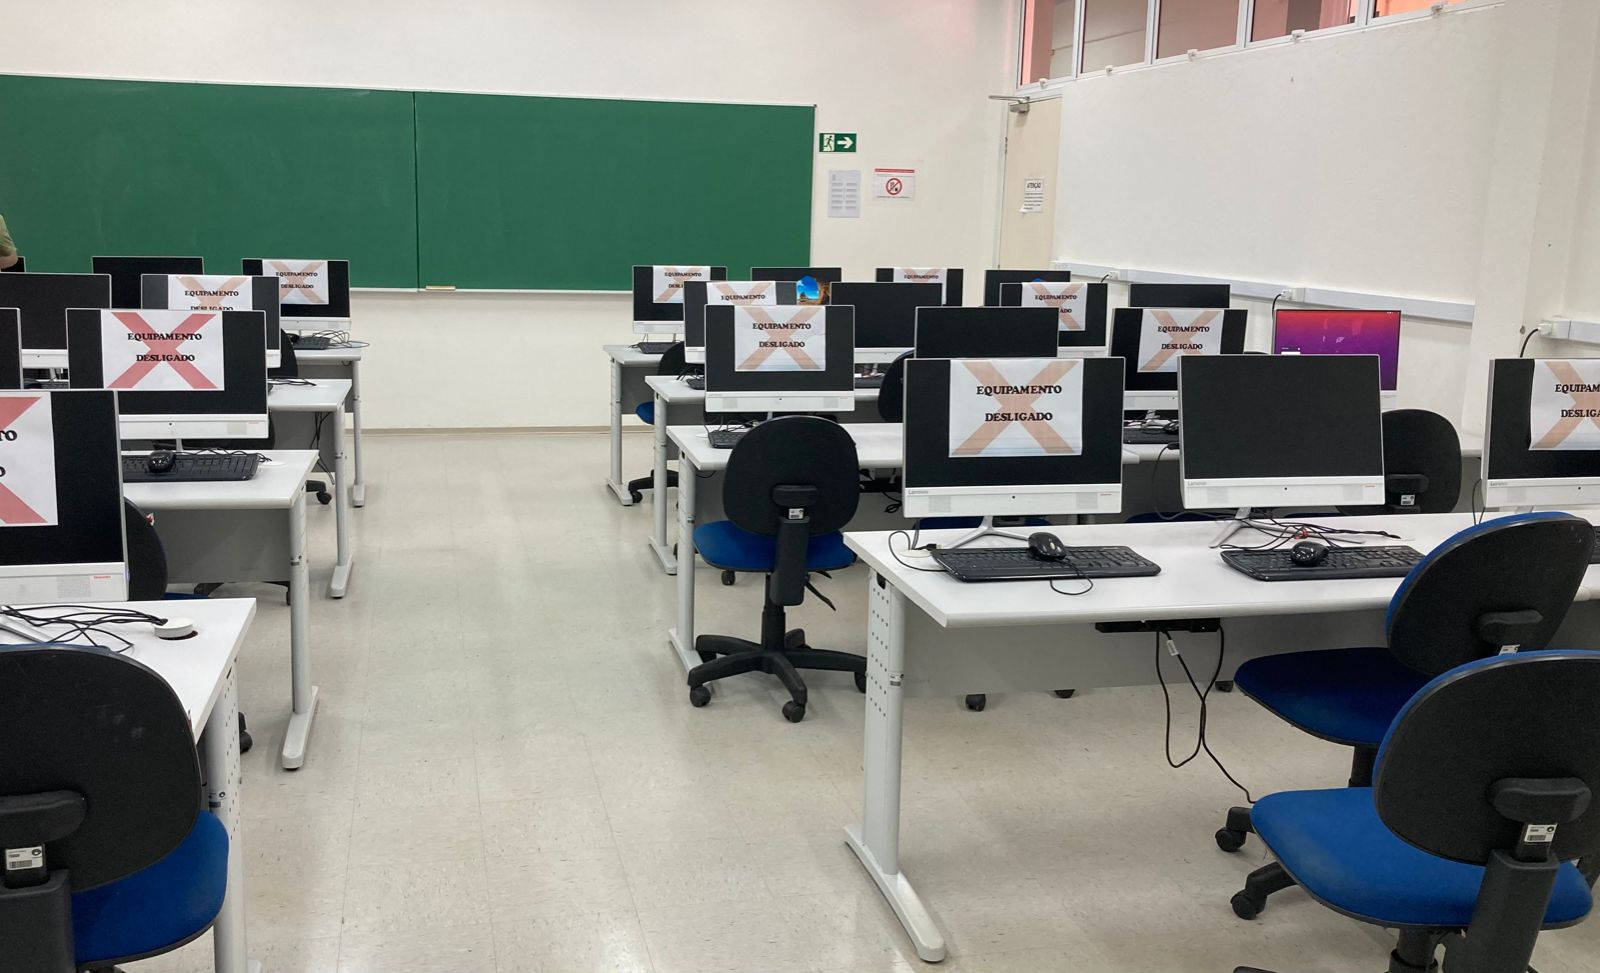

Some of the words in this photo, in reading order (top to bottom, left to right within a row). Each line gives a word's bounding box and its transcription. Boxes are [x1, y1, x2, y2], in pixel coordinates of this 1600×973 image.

[752, 323, 812, 331] EQUIPAMENTO
[1157, 325, 1210, 333] EQUIPAMENTO
[127, 332, 202, 342] EQUIPAMENTO
[1161, 342, 1203, 350] DESLIGADO
[136, 353, 195, 362] DESLIGADO
[976, 384, 1063, 396] EQUIPAMENTO
[1555, 384, 1600, 394] EQUIPAM
[985, 412, 1053, 422] DESLIGADO
